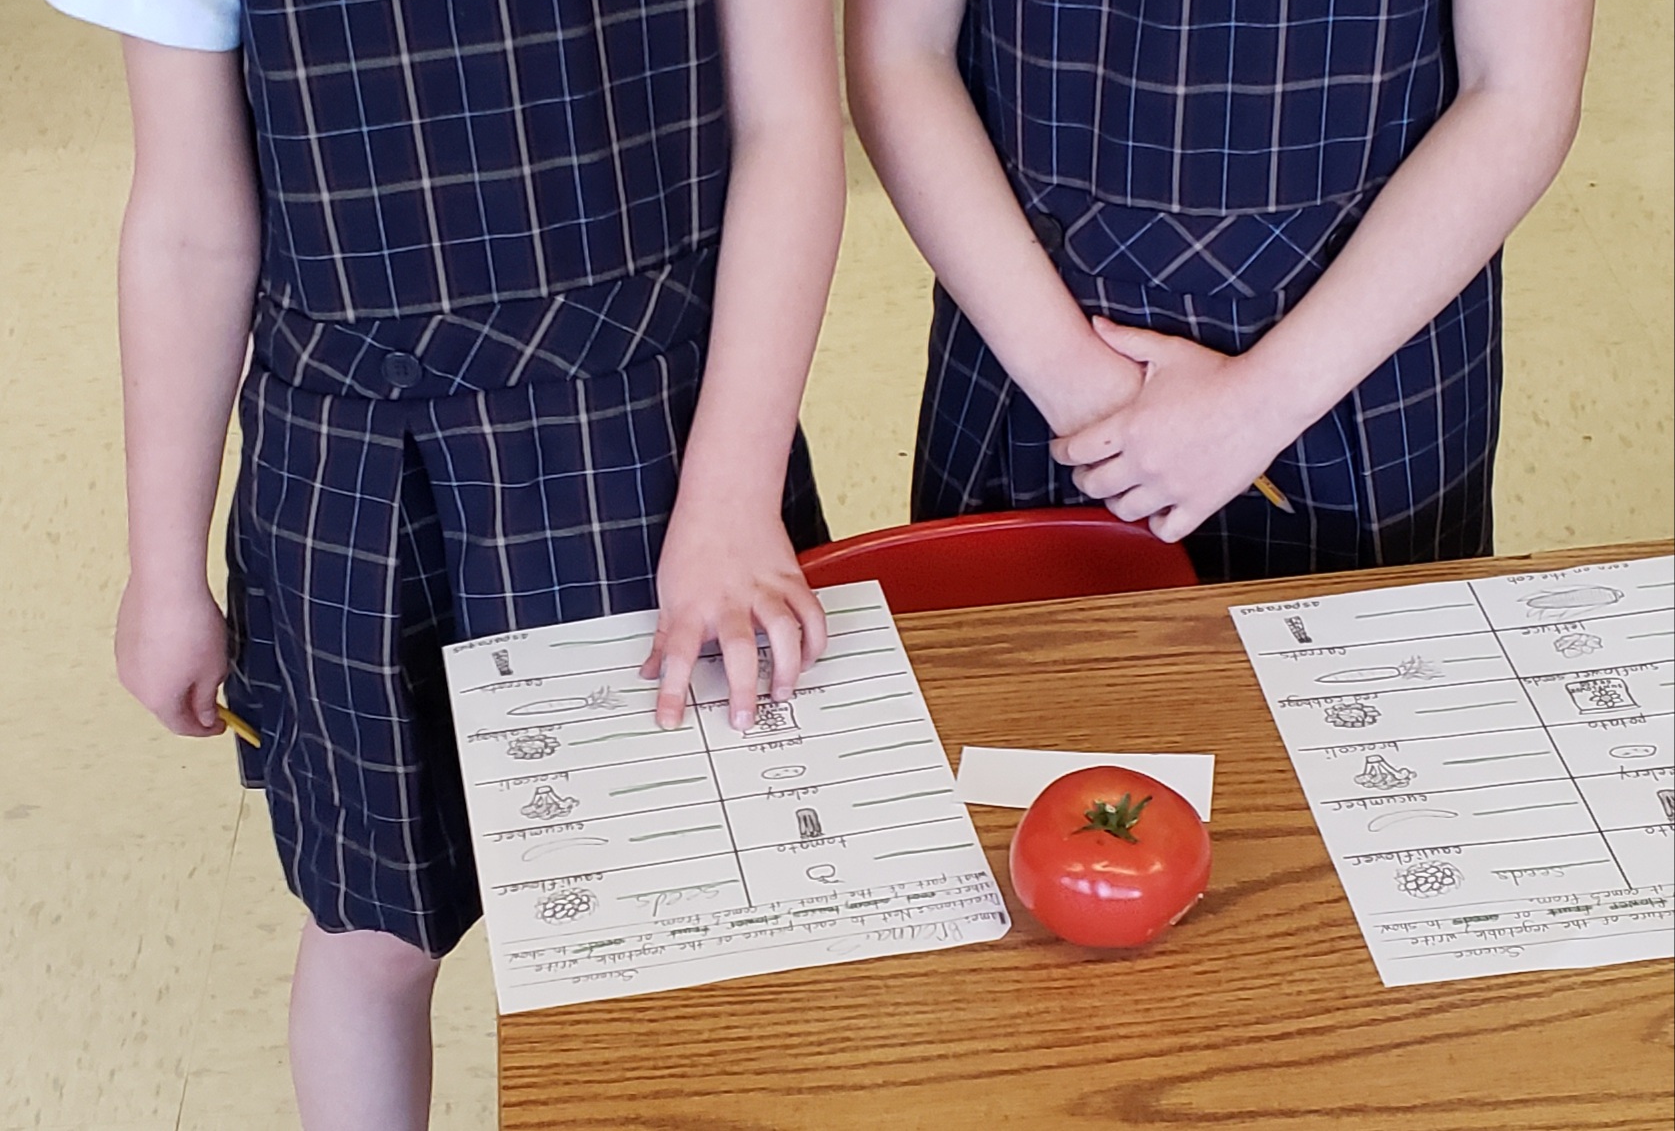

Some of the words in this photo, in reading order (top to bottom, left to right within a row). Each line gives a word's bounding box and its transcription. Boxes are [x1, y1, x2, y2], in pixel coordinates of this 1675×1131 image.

[1506, 574, 1535, 585] cob
[1540, 572, 1567, 582] the
[1239, 600, 1320, 616] asparagus
[1520, 621, 1586, 637] lettuce
[453, 632, 528, 654] asparagus
[1278, 646, 1347, 662] carrots
[1573, 662, 1659, 680] sunflower
[480, 678, 543, 695] carrots
[1523, 674, 1565, 687] seeds
[1587, 712, 1647, 730] potato
[747, 734, 803, 754] potato
[1324, 741, 1399, 760] broccoli
[498, 771, 570, 793] broccoli
[766, 786, 819, 801] celery
[1331, 793, 1428, 812] cucumber
[492, 822, 585, 843] cucumber
[776, 836, 847, 854] tomato
[1351, 844, 1463, 867] cauliflower
[916, 872, 947, 890] part
[1493, 866, 1565, 887] seeds
[495, 872, 603, 897] cauliflower
[889, 883, 905, 894] of
[1649, 884, 1663, 895] it
[797, 889, 838, 908] plant
[848, 888, 872, 900] the
[768, 900, 780, 911] it
[851, 916, 865, 927] to
[1513, 910, 1531, 920] or
[1601, 915, 1620, 926] of
[742, 920, 794, 940] picture
[802, 920, 837, 933] each
[1380, 923, 1417, 934] show
[1559, 919, 1590, 931] the
[677, 940, 703, 952] the
[715, 934, 733, 945] of
[1409, 932, 1457, 946] write
[509, 949, 546, 963] show
[1453, 945, 1525, 960] Science
[534, 959, 578, 973] write
[571, 969, 639, 985] Science
